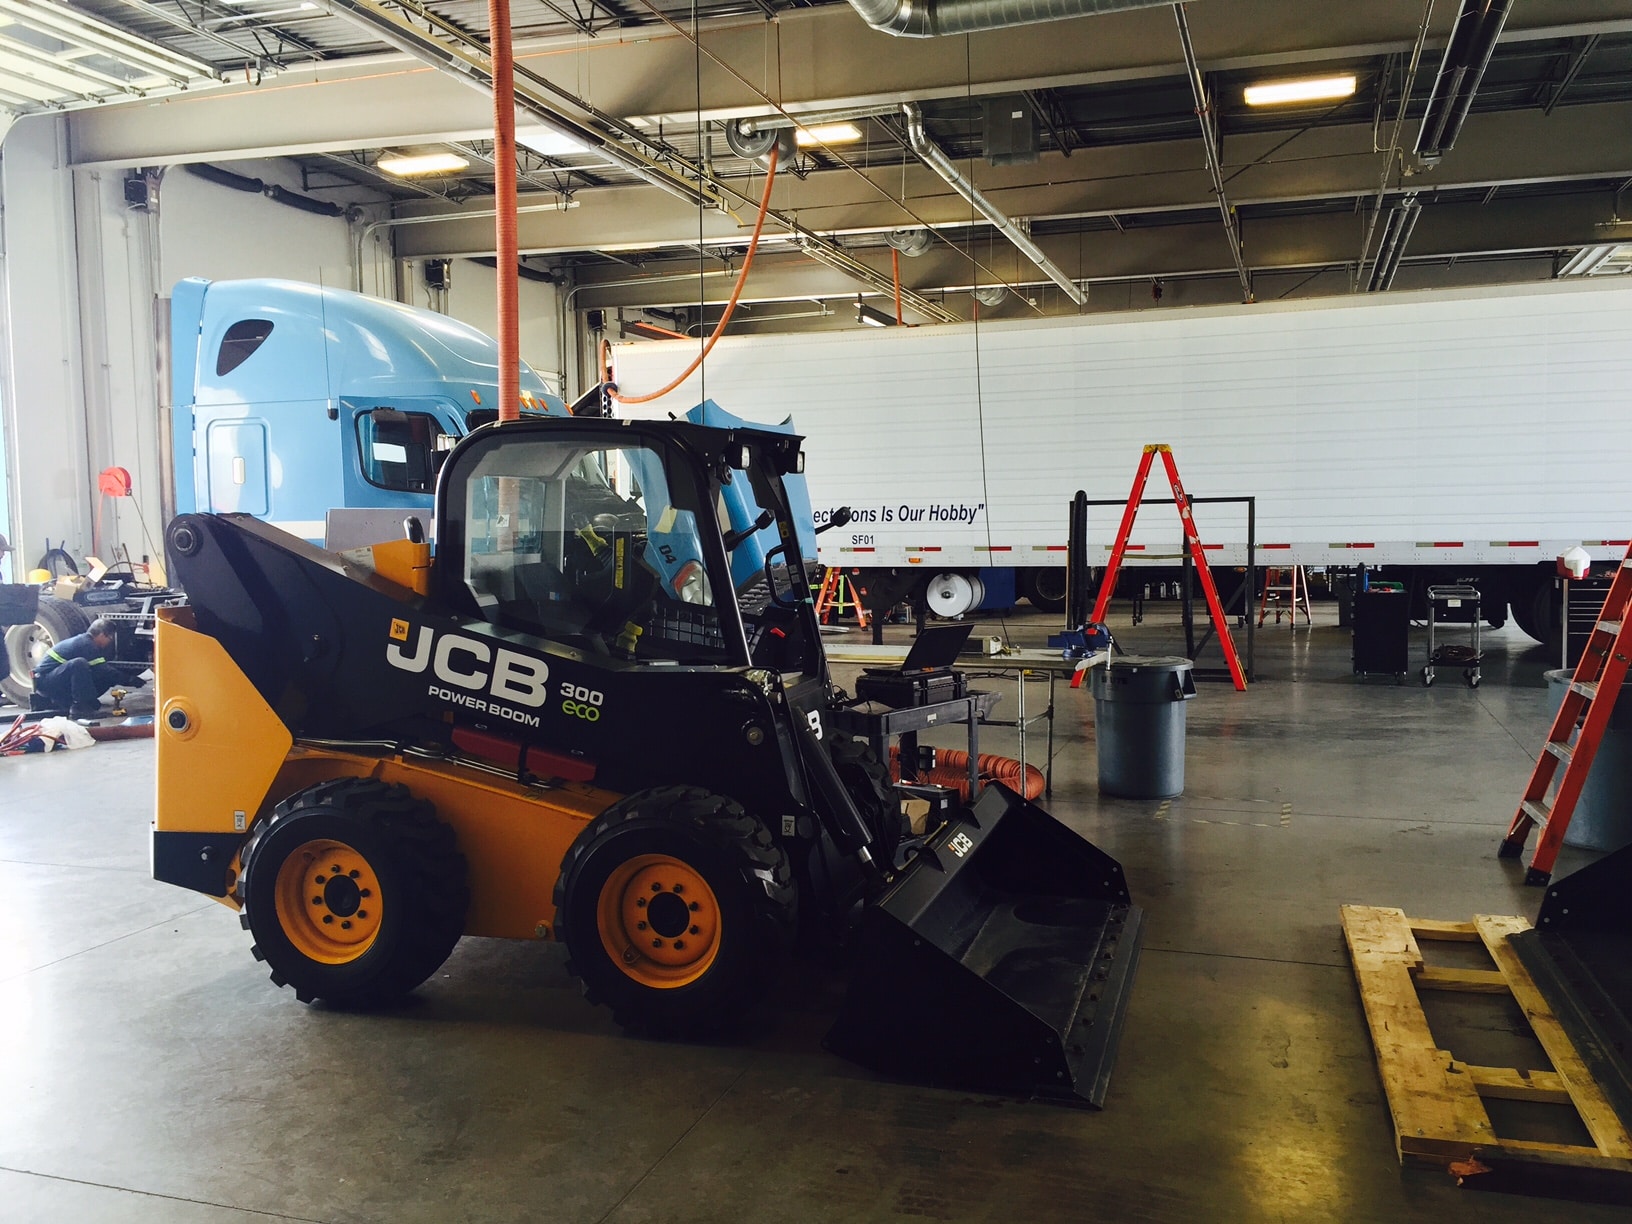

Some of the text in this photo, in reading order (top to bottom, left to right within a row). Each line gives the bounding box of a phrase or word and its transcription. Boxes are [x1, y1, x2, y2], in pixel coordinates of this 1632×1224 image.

[881, 505, 893, 522] Is
[898, 504, 925, 522] Our
[928, 503, 985, 525] Hobby"
[851, 534, 874, 545] SF01
[386, 625, 550, 708] JCB
[427, 685, 541, 728] POWER BOOM
[559, 681, 604, 707] 300
[561, 699, 601, 722] eco
[949, 832, 974, 858] JCB
